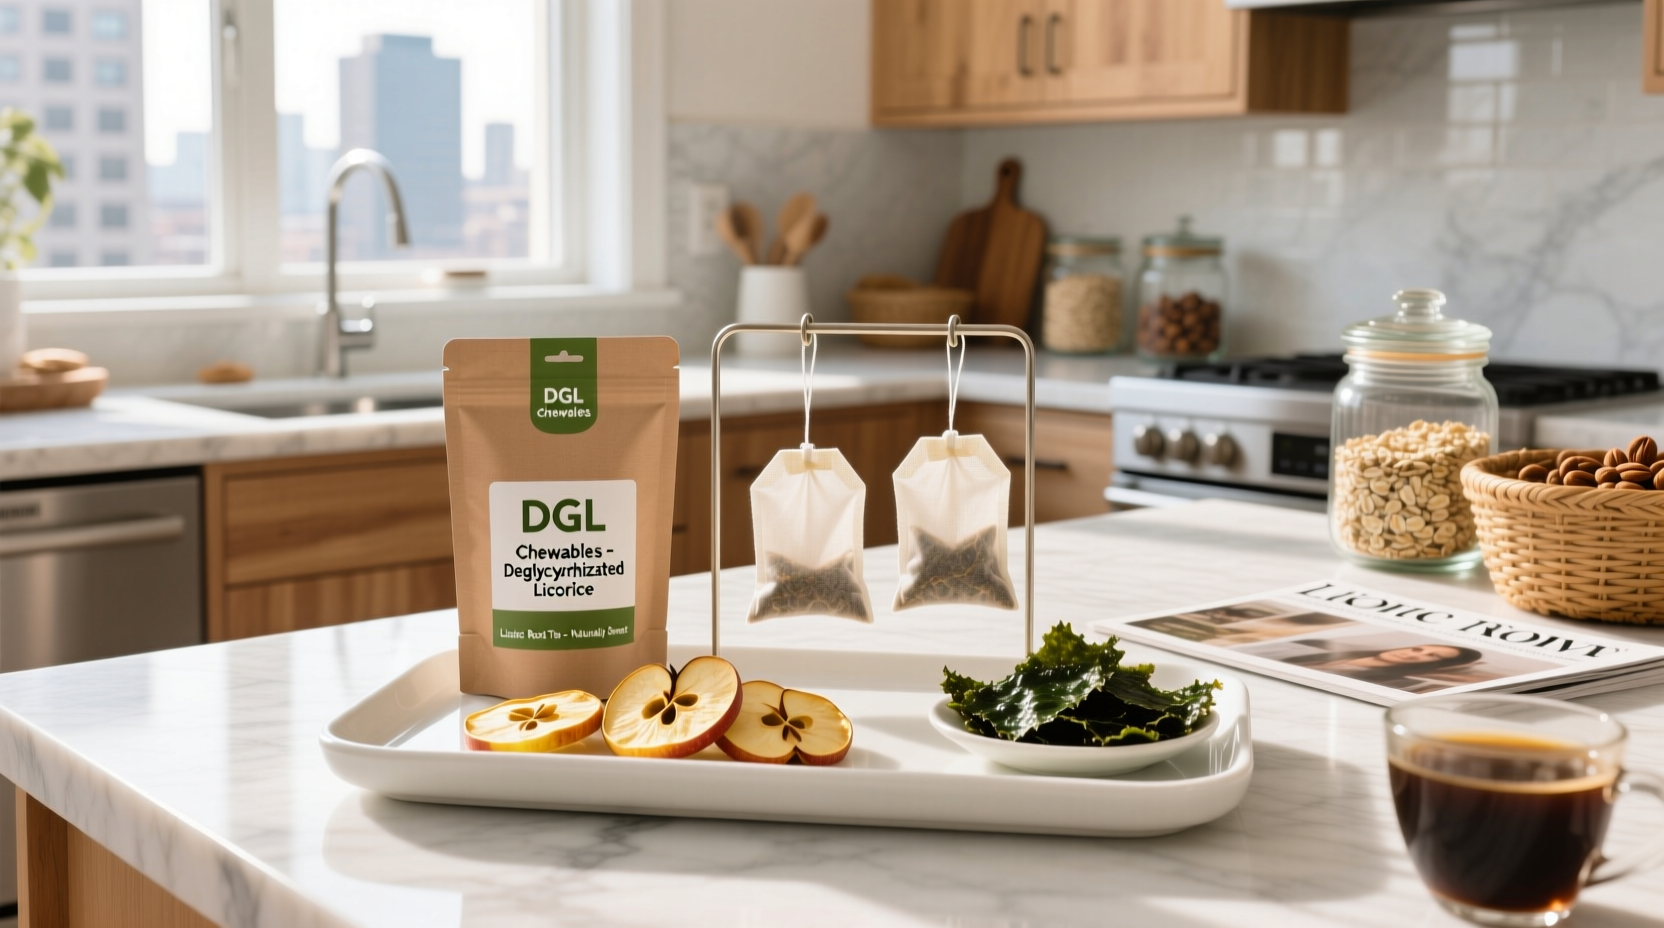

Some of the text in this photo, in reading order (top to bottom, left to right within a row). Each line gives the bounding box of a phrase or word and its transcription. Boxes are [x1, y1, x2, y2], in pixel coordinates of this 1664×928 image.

[544, 387, 584, 404] DGL
[522, 498, 606, 533] DGL
[516, 543, 603, 560] Chewables
[534, 581, 594, 597] Licorice
